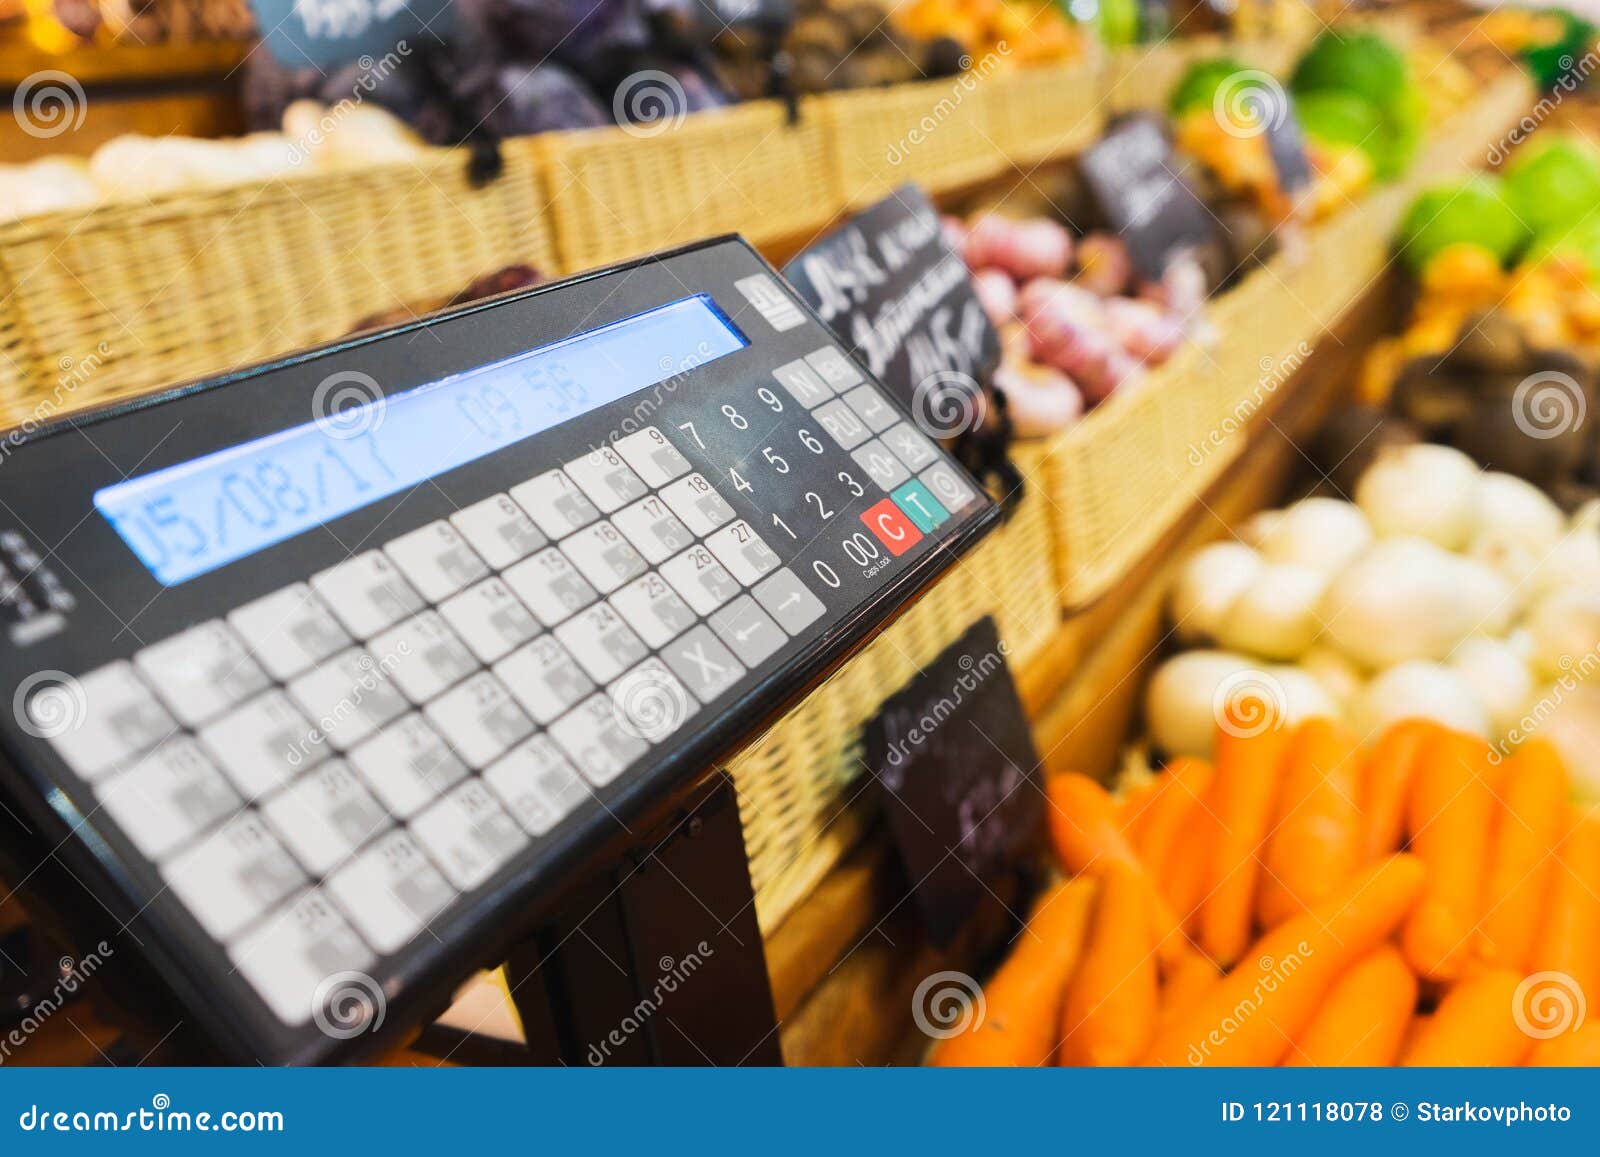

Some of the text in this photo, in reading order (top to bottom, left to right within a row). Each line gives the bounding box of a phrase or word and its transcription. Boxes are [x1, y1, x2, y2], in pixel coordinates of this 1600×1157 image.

[757, 388, 783, 412] 9
[722, 404, 748, 430] 8
[649, 429, 664, 444] 9
[679, 421, 706, 449] 7
[798, 429, 824, 454] 6
[603, 450, 619, 466] 8
[762, 447, 790, 474] 5
[551, 472, 567, 489] 7
[687, 476, 709, 495] 18
[729, 467, 754, 493] 4
[839, 472, 864, 497] 3
[498, 497, 515, 515] 6
[642, 499, 663, 519] 17
[805, 492, 834, 519] 2
[905, 491, 932, 518] T
[594, 525, 618, 544] 16
[731, 523, 752, 543] 27
[773, 513, 797, 539] 1
[877, 513, 905, 540] C
[541, 551, 565, 573] 15
[688, 549, 712, 570] 26
[842, 532, 878, 567] 00
[812, 560, 841, 588] 0
[863, 554, 891, 579] Caps Lock
[640, 576, 666, 599] 25
